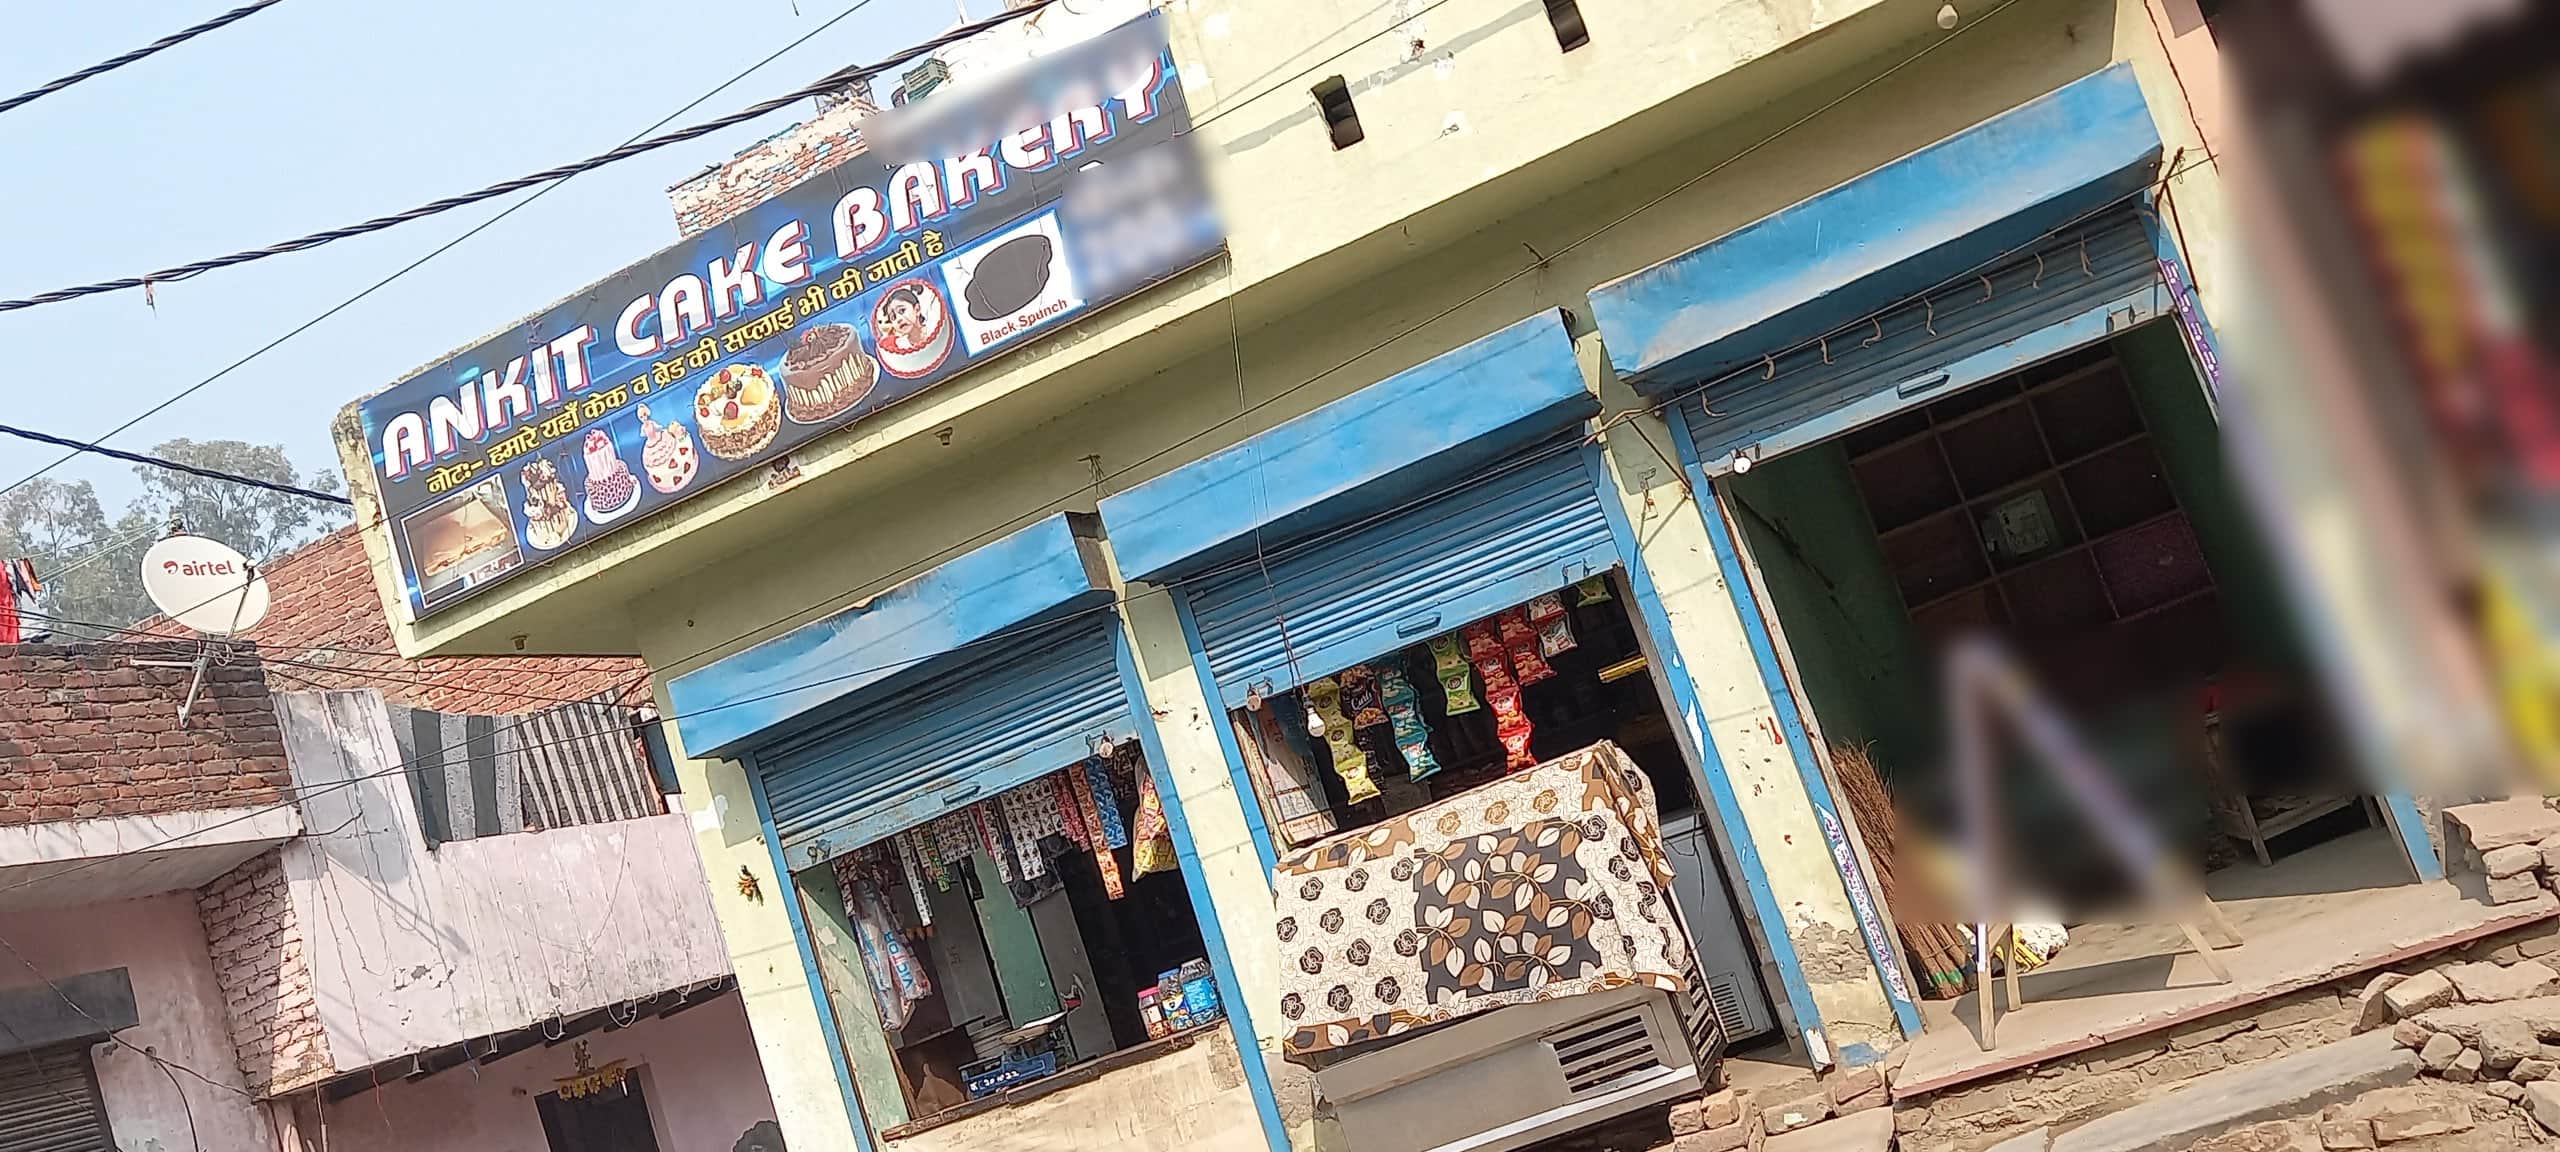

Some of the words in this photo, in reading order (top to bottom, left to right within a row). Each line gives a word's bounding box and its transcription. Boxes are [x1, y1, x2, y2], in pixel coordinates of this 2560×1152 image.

[382, 323, 598, 482] ANKIT
[613, 219, 813, 358] CAKE
[487, 425, 540, 466] हमारे
[540, 401, 580, 439] यहाँ
[582, 382, 629, 420] केक
[630, 375, 650, 397] व
[651, 355, 687, 390] ब्रेड
[686, 336, 720, 369] की
[720, 296, 796, 354] सप्लाई
[797, 282, 828, 318] भी
[828, 267, 865, 301] की
[866, 240, 922, 284] जाती
[921, 229, 945, 259] है
[980, 321, 1016, 345] Black
[1018, 298, 1068, 327] Spunch
[182, 560, 236, 576] airtel
